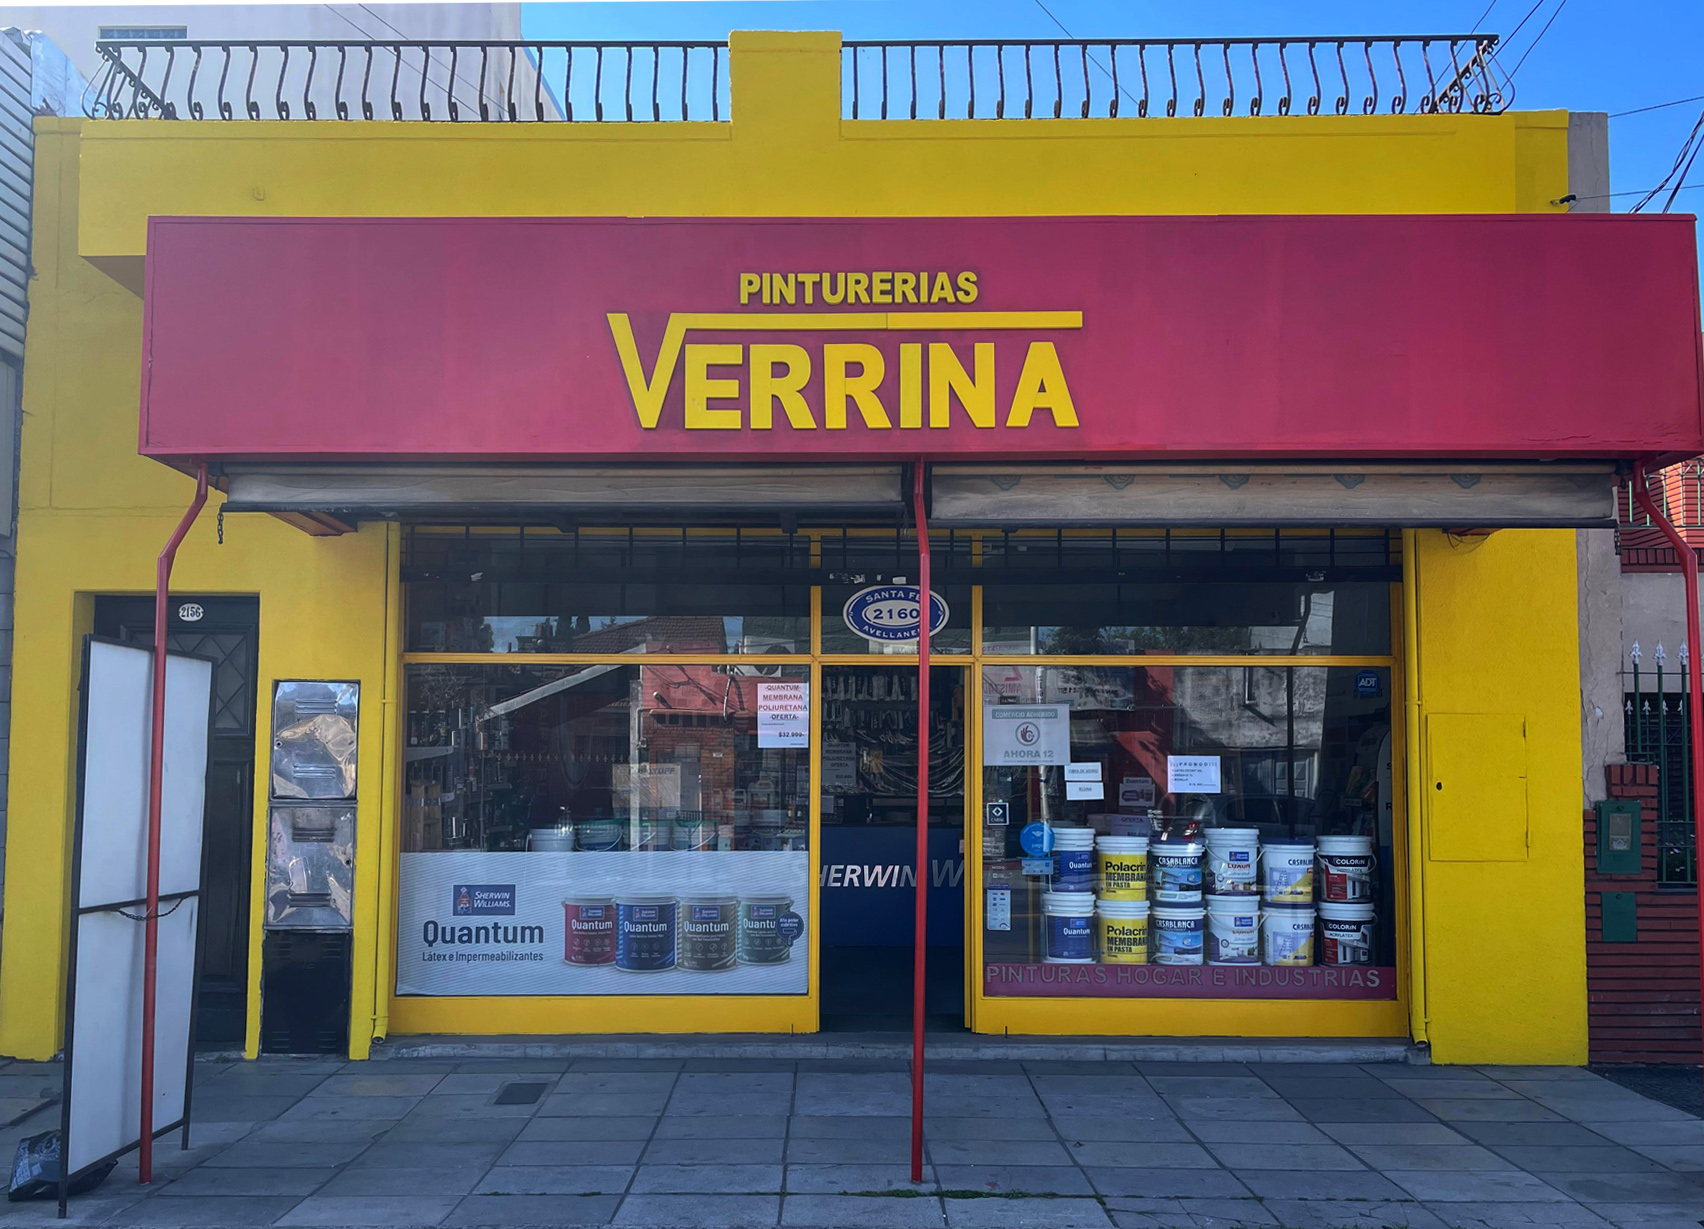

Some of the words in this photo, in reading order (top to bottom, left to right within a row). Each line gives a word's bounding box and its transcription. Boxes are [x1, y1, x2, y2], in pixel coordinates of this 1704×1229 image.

[739, 271, 979, 305] PINTURERIAS
[606, 311, 1083, 430] VERRINA
[865, 590, 905, 603] SANTA
[181, 606, 201, 618] 2156
[873, 608, 920, 620] 2160
[862, 625, 921, 638] AVELLANE
[1358, 677, 1377, 687] ADT
[758, 704, 808, 712] POLIURETANA
[1003, 750, 1041, 758] AHORA
[1043, 750, 1054, 758] 12
[1158, 857, 1198, 865] CASABLANCA
[475, 891, 511, 899] SHERWIN
[571, 919, 613, 930] Quantum
[624, 921, 668, 932] Quantum
[683, 920, 729, 932] Quantum
[743, 918, 776, 929] Quantu
[1156, 919, 1195, 929] CASABLANCA
[423, 920, 544, 947] Quantum
[422, 951, 447, 962] Látex
[456, 951, 544, 963] Impermeabilizantes
[986, 966, 1107, 983] PINTURAS
[1117, 967, 1203, 985] HOGAR
[1213, 968, 1225, 985] E
[1235, 969, 1381, 988] INDUSTRIAS
